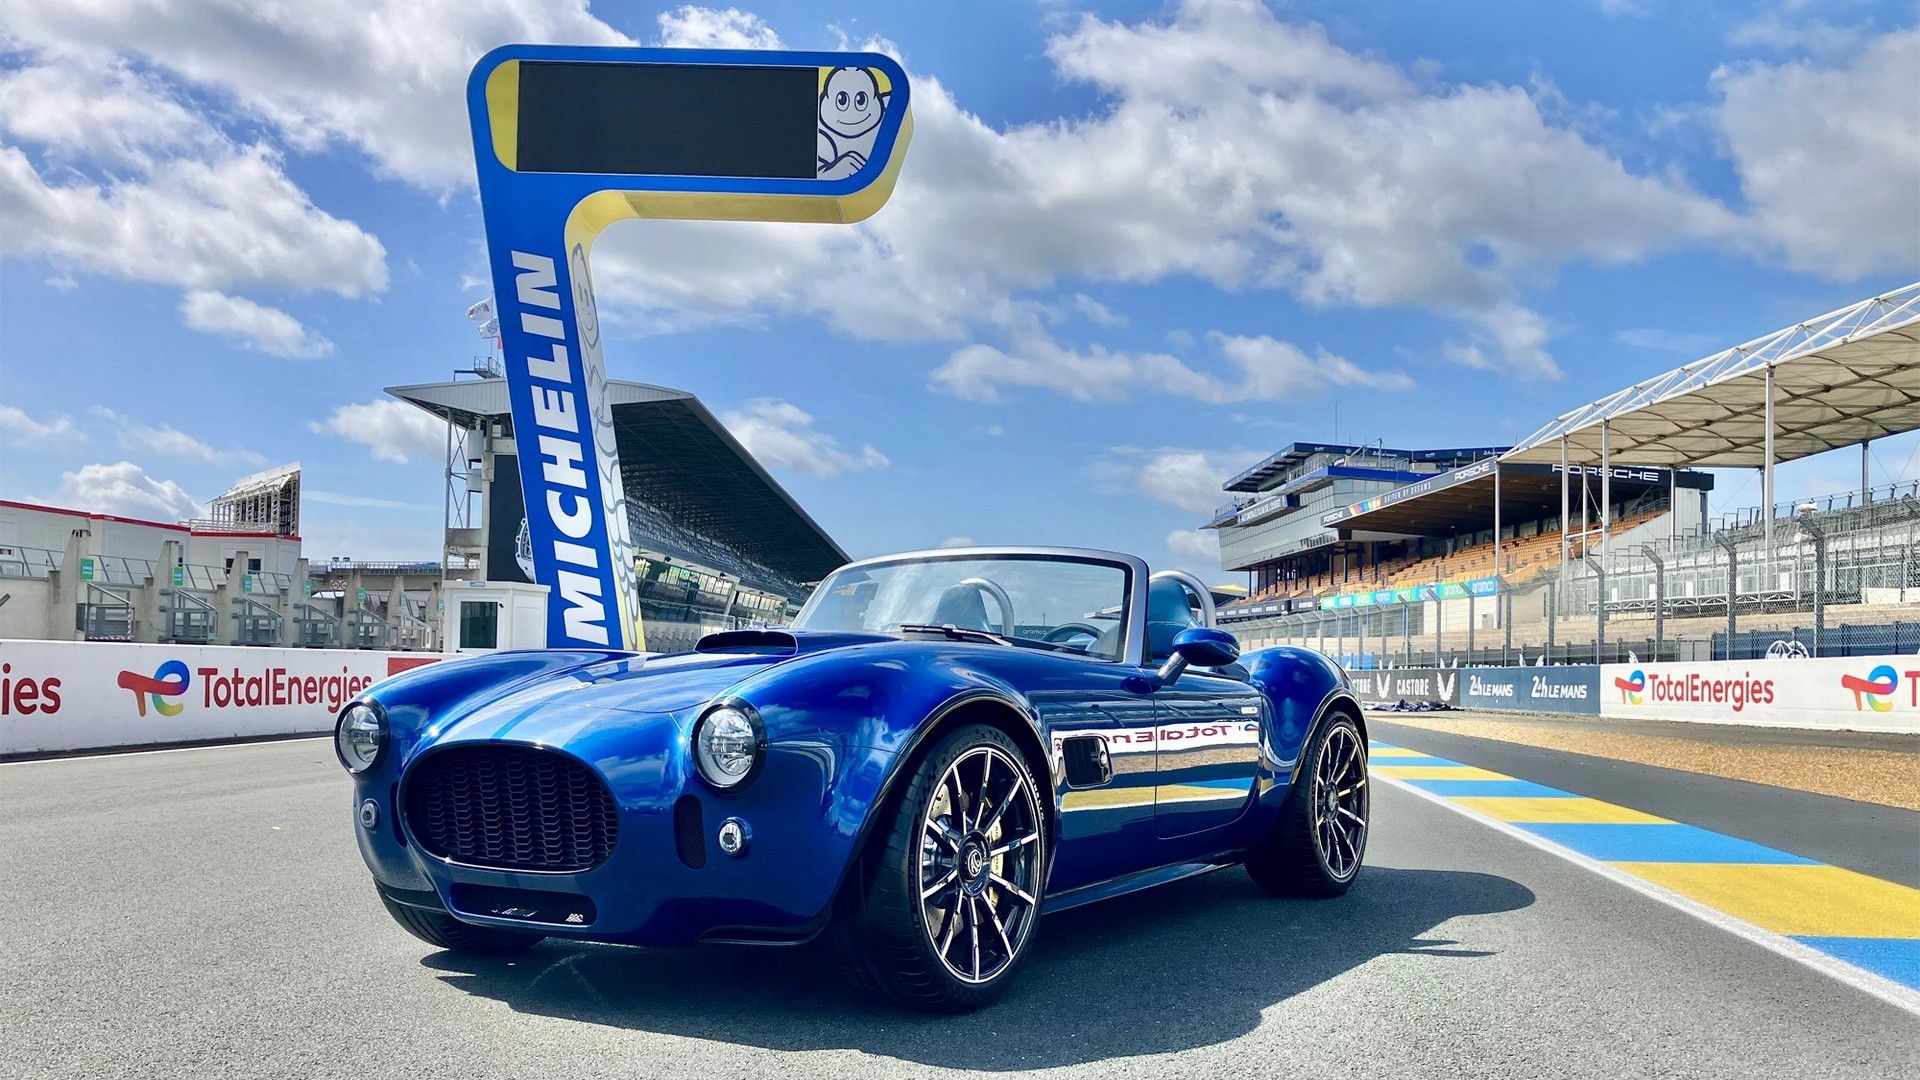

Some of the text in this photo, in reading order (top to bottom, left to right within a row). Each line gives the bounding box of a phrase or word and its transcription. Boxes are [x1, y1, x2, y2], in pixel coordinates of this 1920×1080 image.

[511, 250, 609, 646] MICHELIN
[1455, 462, 1490, 481] PORSCHE
[1397, 678, 1429, 696] CASTORE
[1492, 684, 1514, 697] MANS
[1561, 685, 1587, 699] MANS
[1648, 671, 1774, 712] TotalEnergies
